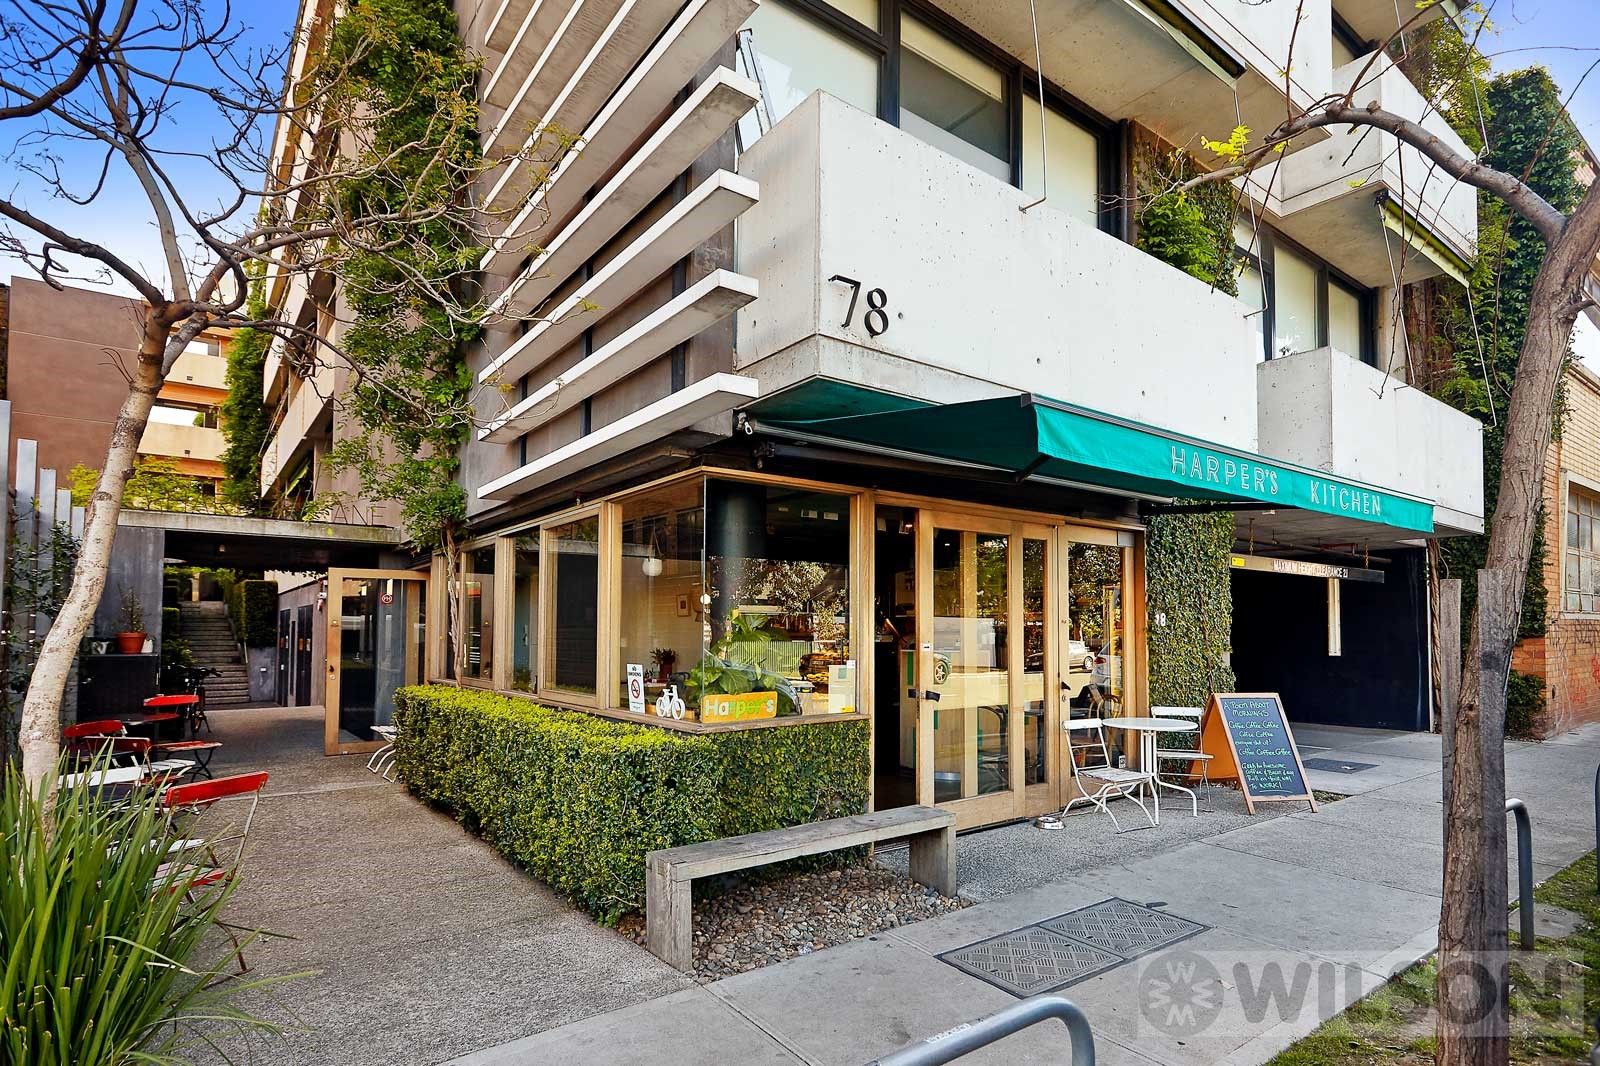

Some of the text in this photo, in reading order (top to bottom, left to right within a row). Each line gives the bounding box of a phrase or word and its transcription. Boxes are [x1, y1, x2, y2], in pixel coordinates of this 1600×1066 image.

[828, 274, 889, 339] 78
[329, 500, 387, 526] ANE
[1171, 446, 1382, 517] HARPER'S KITCHEN
